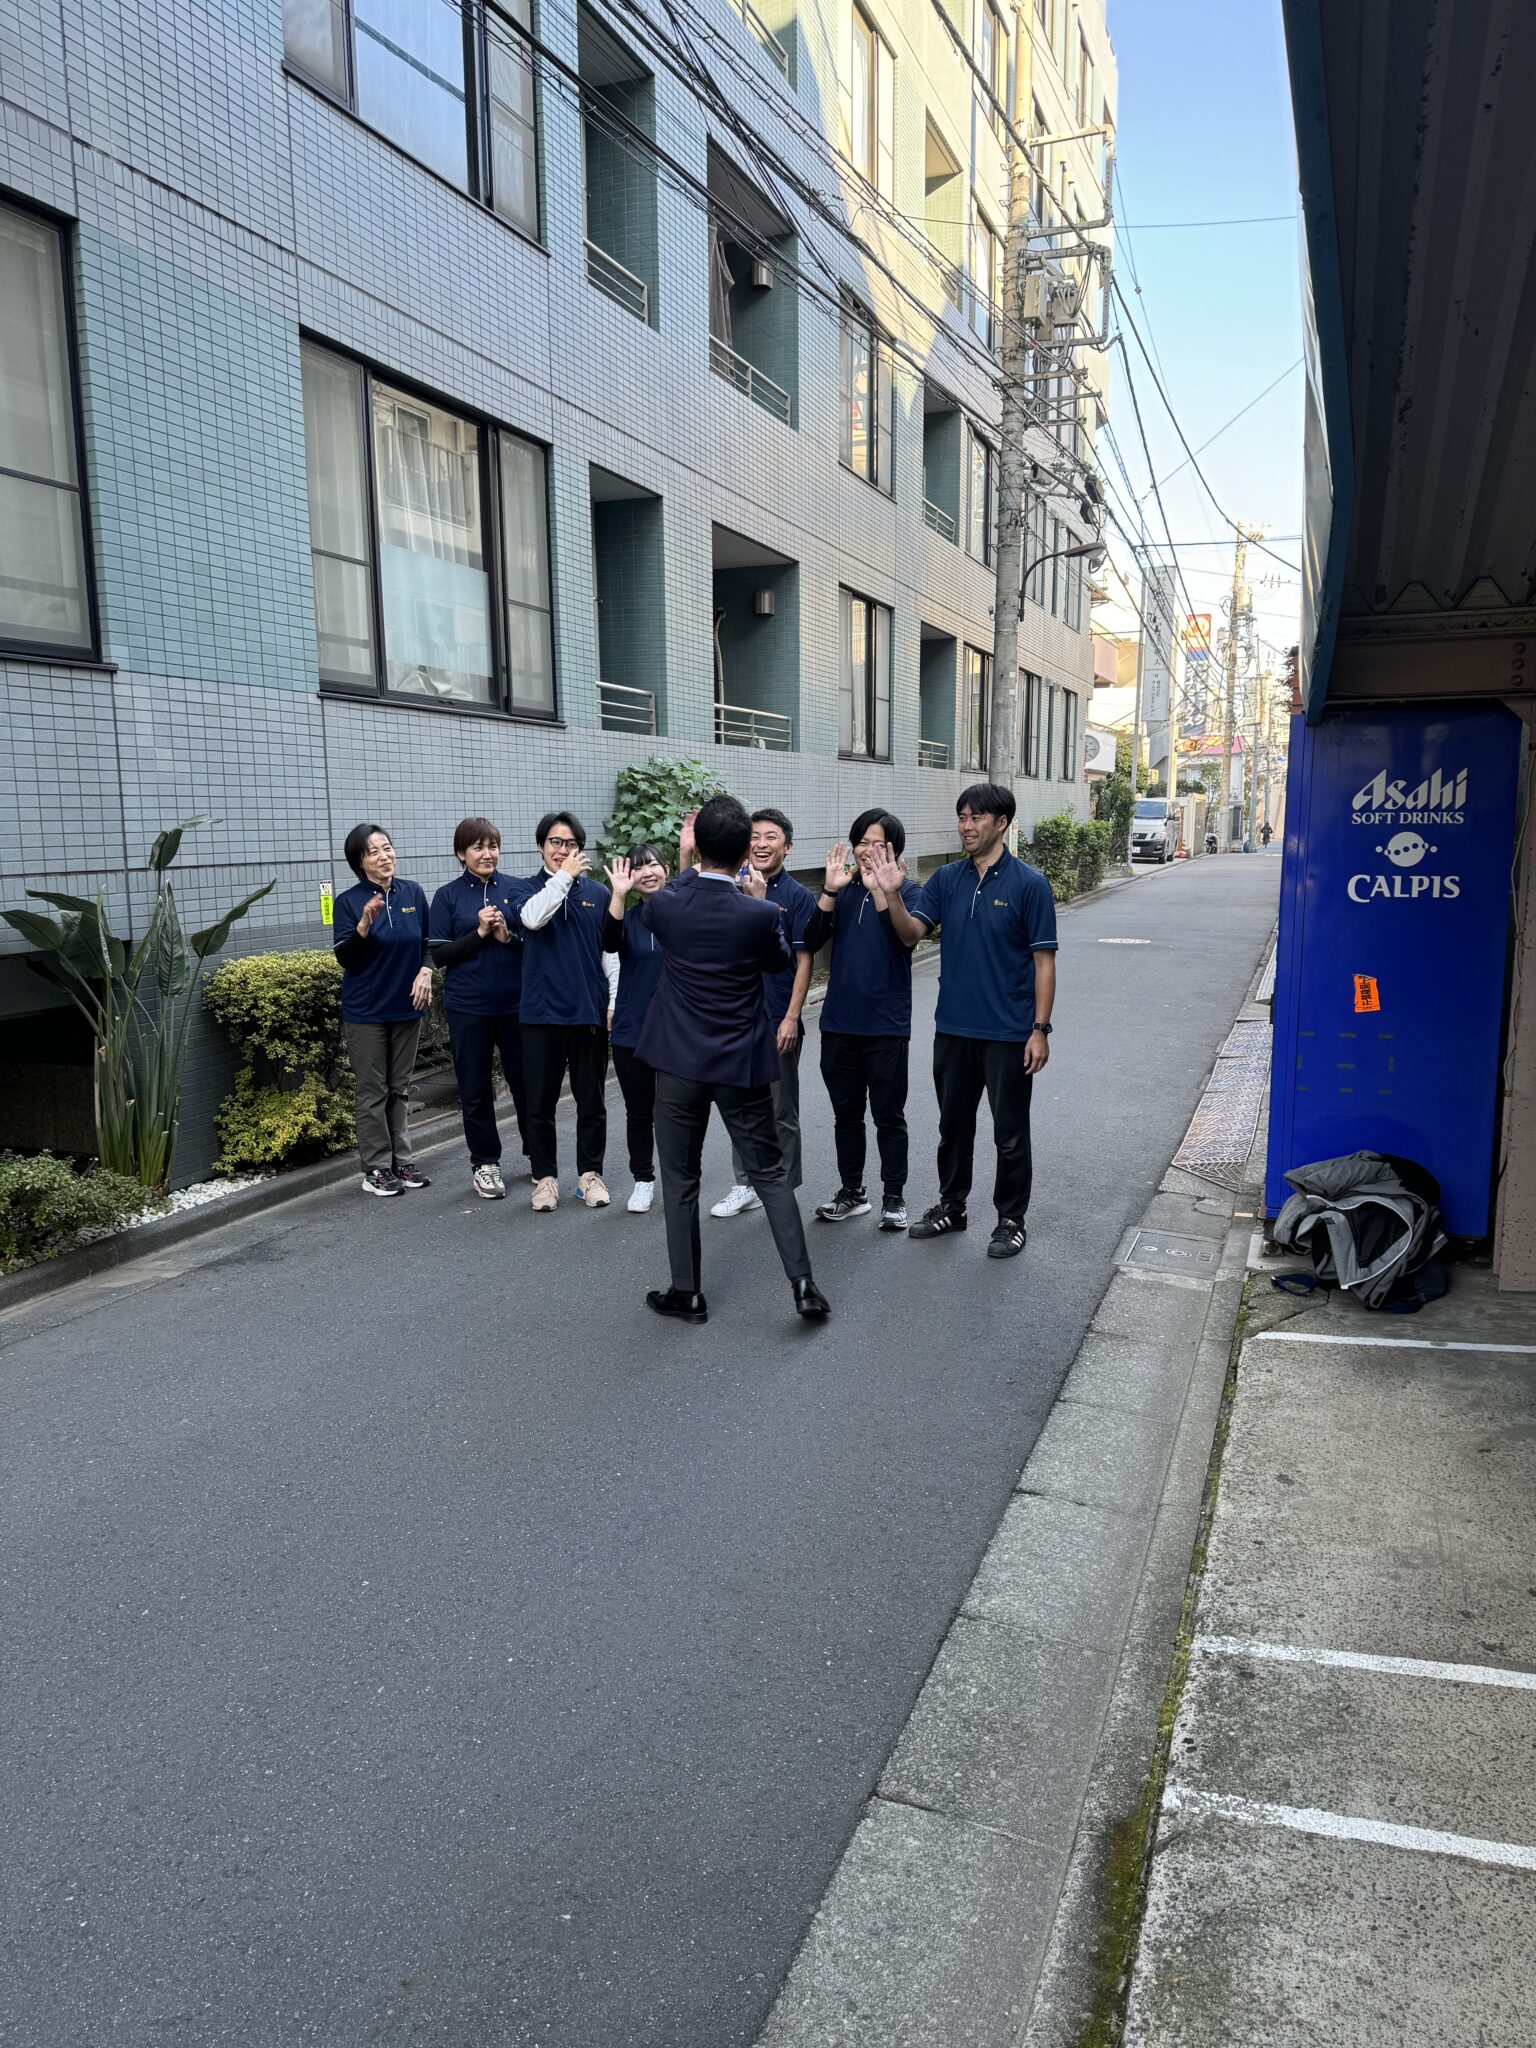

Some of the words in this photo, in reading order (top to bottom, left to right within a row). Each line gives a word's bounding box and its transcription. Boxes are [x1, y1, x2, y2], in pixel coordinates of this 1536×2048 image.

[1352, 768, 1468, 810] Asahi
[1352, 812, 1395, 824] SOFT
[1400, 812, 1464, 824] DRINKS
[1347, 874, 1460, 903] CALPIS
